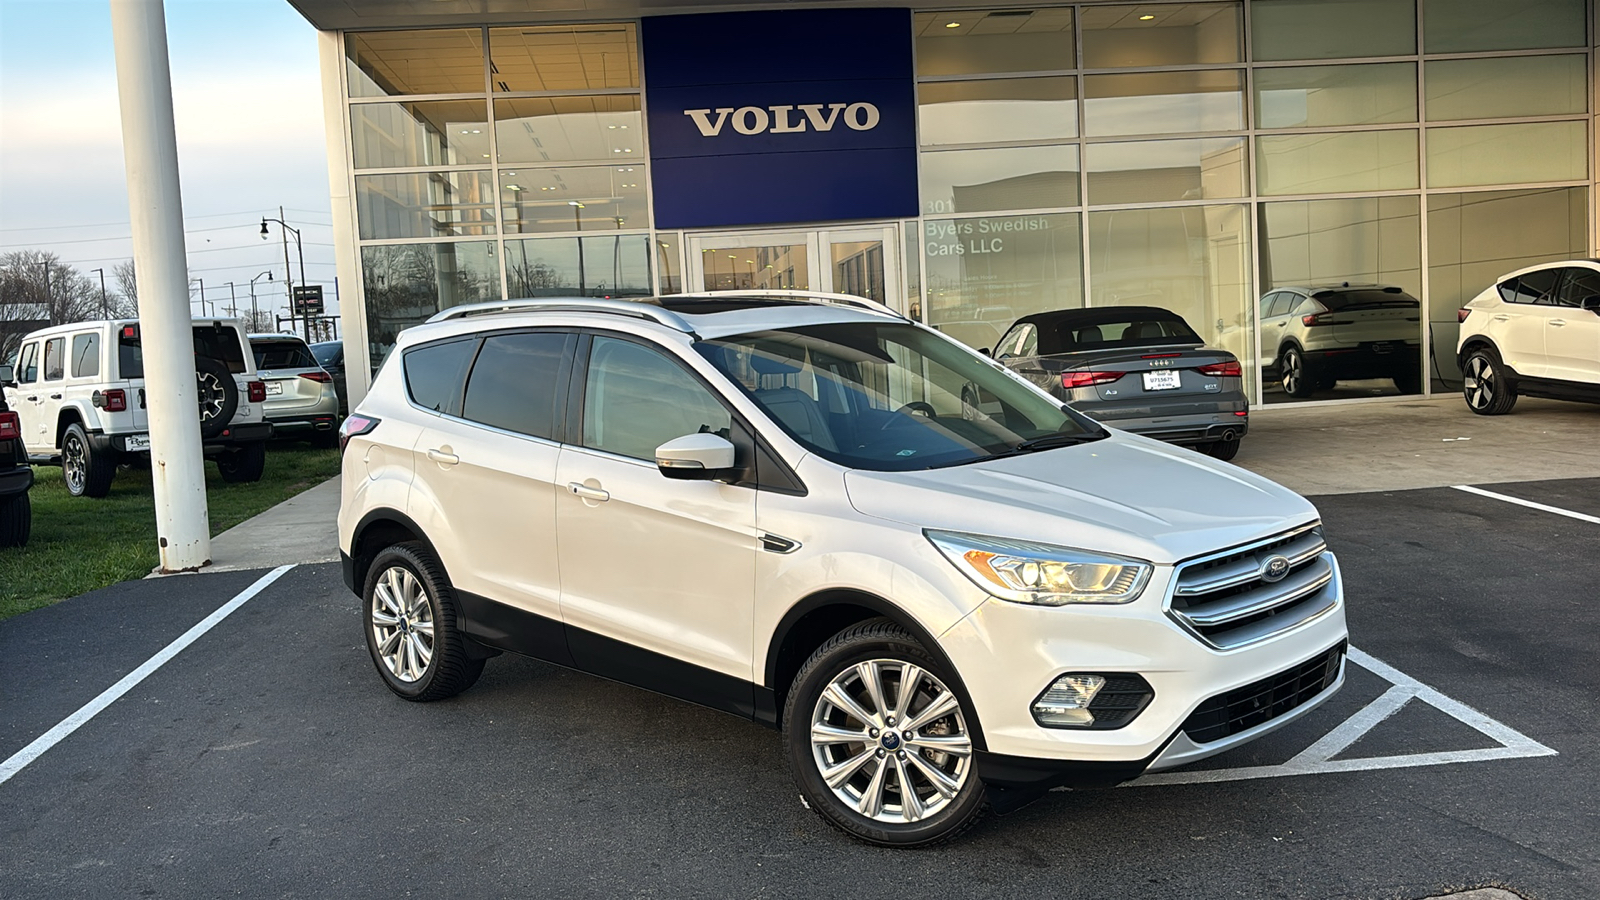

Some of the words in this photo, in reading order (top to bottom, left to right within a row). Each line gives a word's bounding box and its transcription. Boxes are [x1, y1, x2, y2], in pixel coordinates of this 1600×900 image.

[683, 102, 880, 137] VOLVO
[927, 200, 953, 214] 301
[927, 222, 973, 239] Byers
[979, 218, 1048, 233] Swedish
[927, 242, 965, 256] Cars
[970, 238, 1003, 254] LLC
[1269, 560, 1287, 576] Ford
